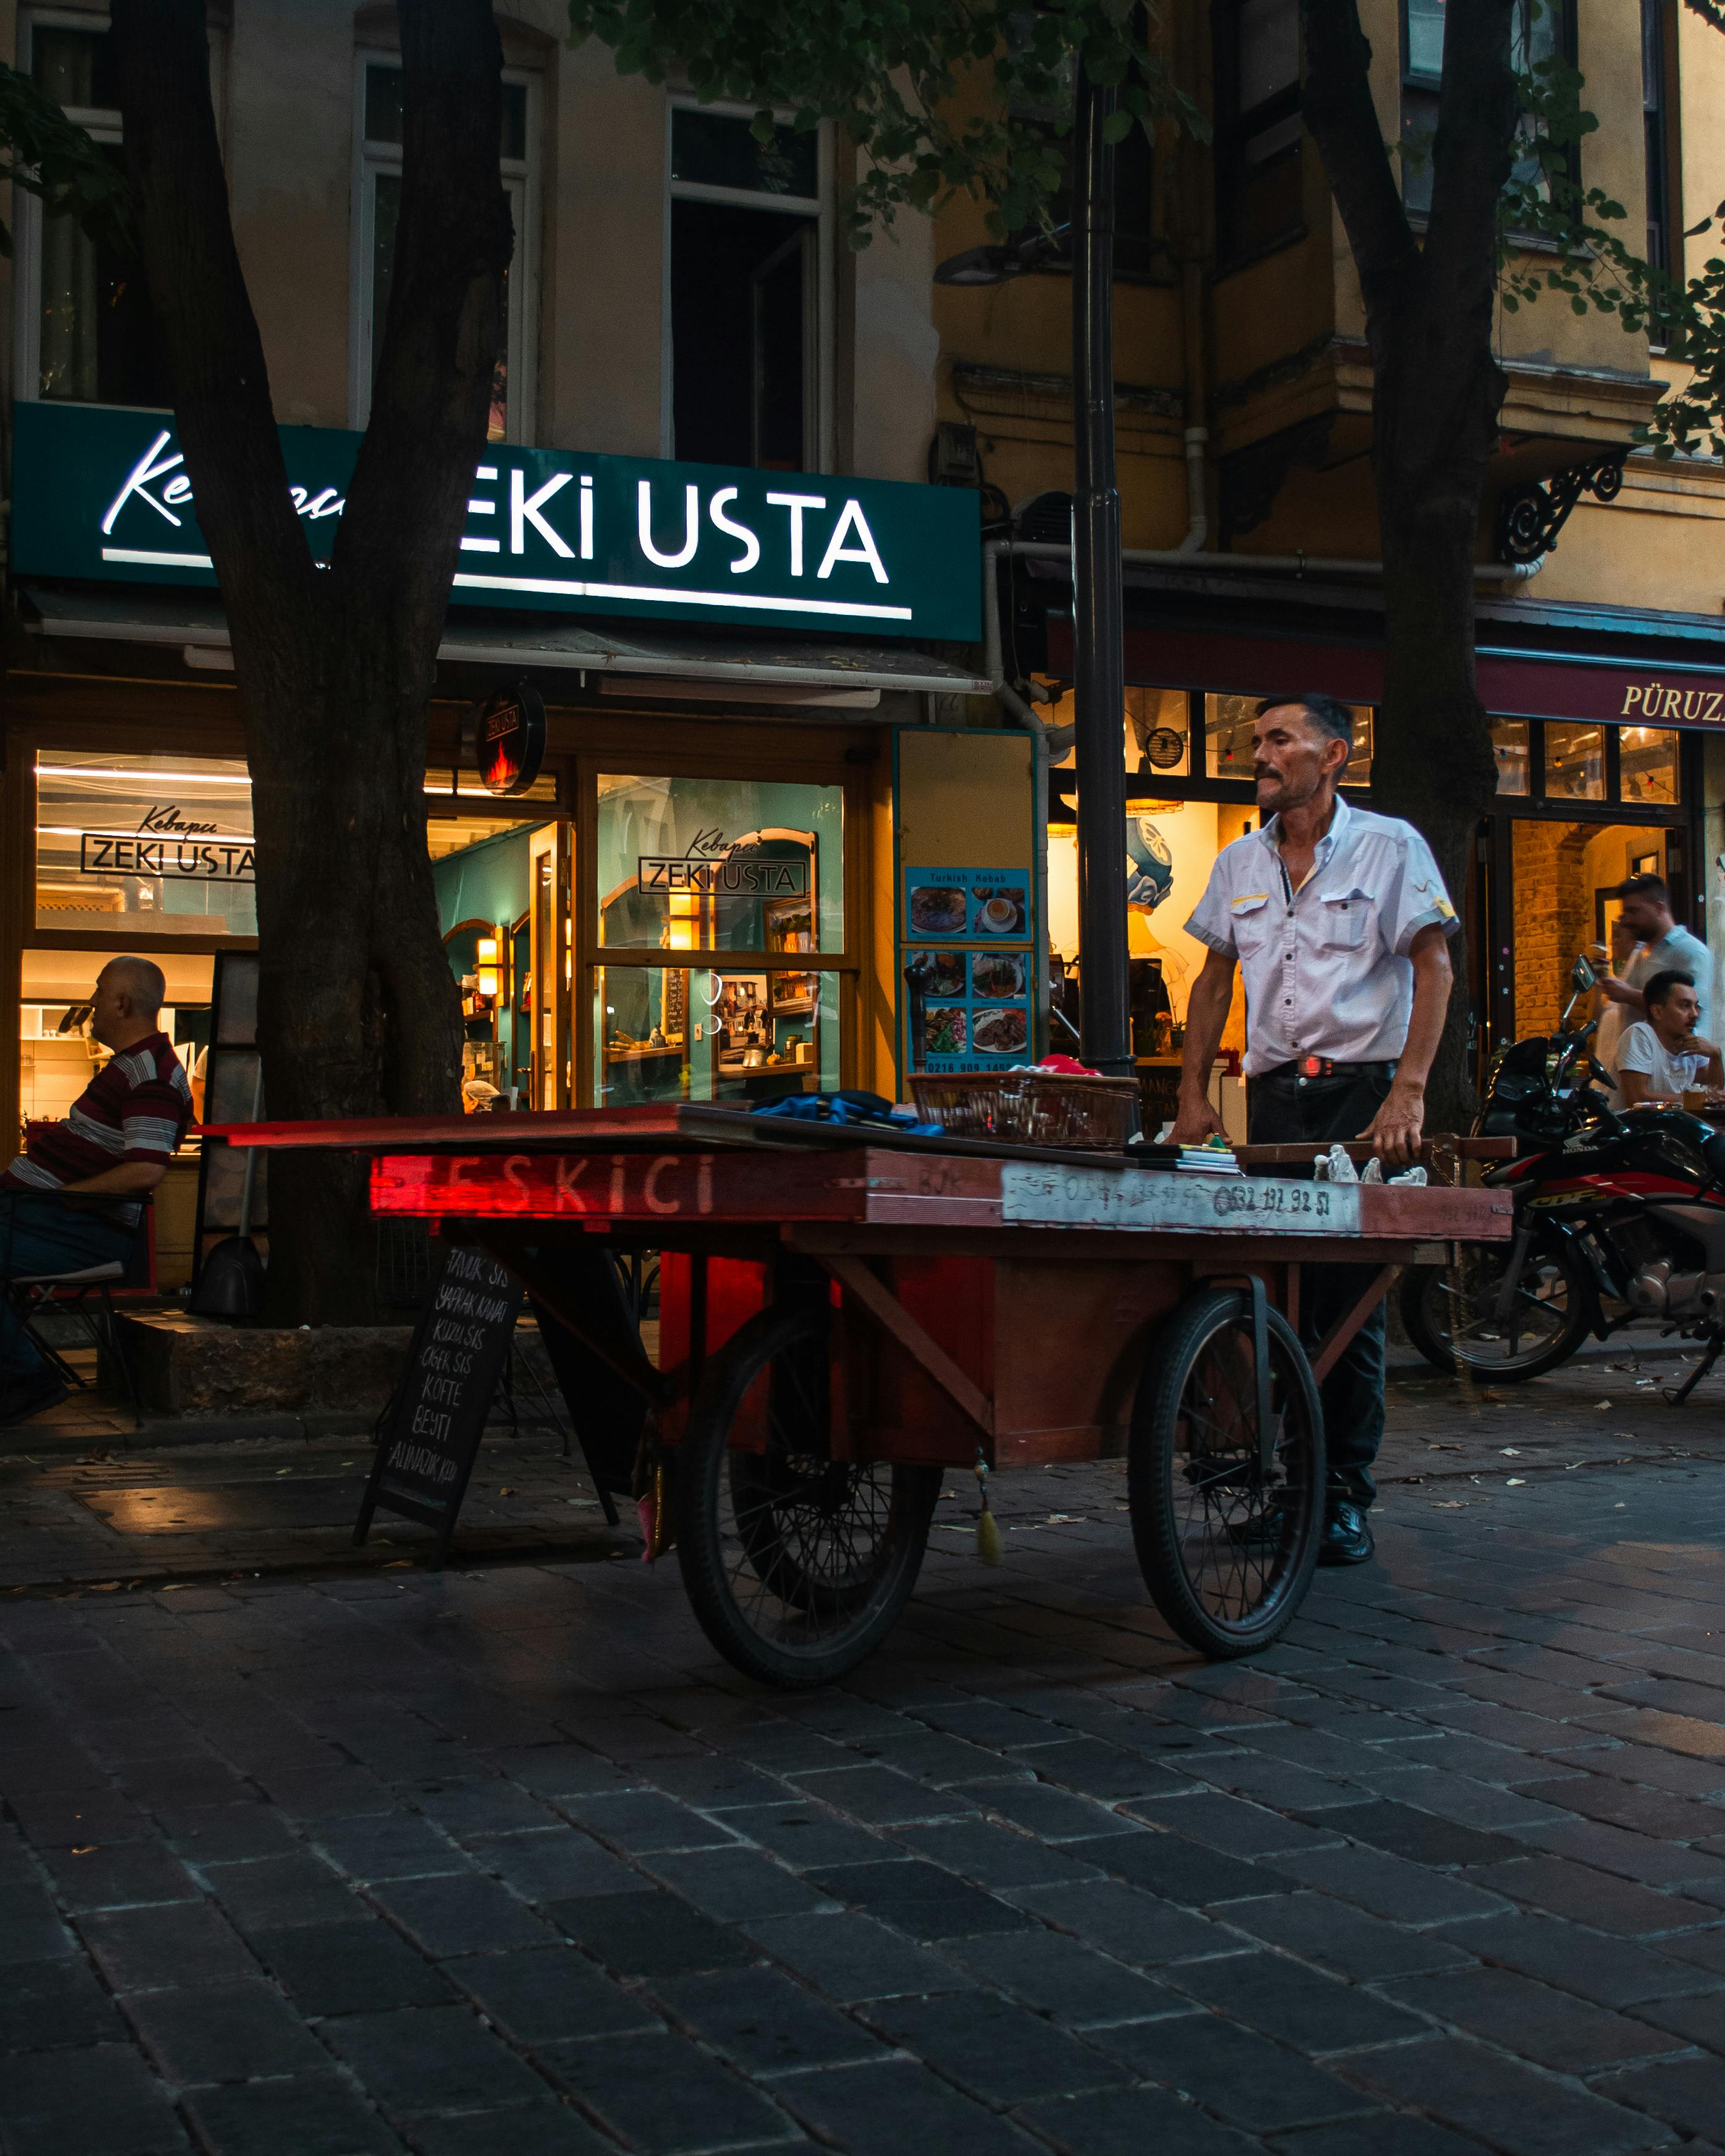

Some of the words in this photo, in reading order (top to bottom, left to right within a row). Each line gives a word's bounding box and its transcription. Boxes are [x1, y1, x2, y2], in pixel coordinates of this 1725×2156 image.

[638, 479, 890, 584] USTA
[1620, 682, 1725, 722] PÜRUZ
[177, 844, 255, 875] USTA
[722, 864, 796, 891] USTA
[930, 873, 968, 883] Turkish
[976, 874, 1006, 883] Kebab
[928, 1063, 954, 1073] 0216
[960, 1063, 979, 1072] 909
[1562, 1145, 1599, 1154] HONDA
[447, 1248, 486, 1281] TAVUK
